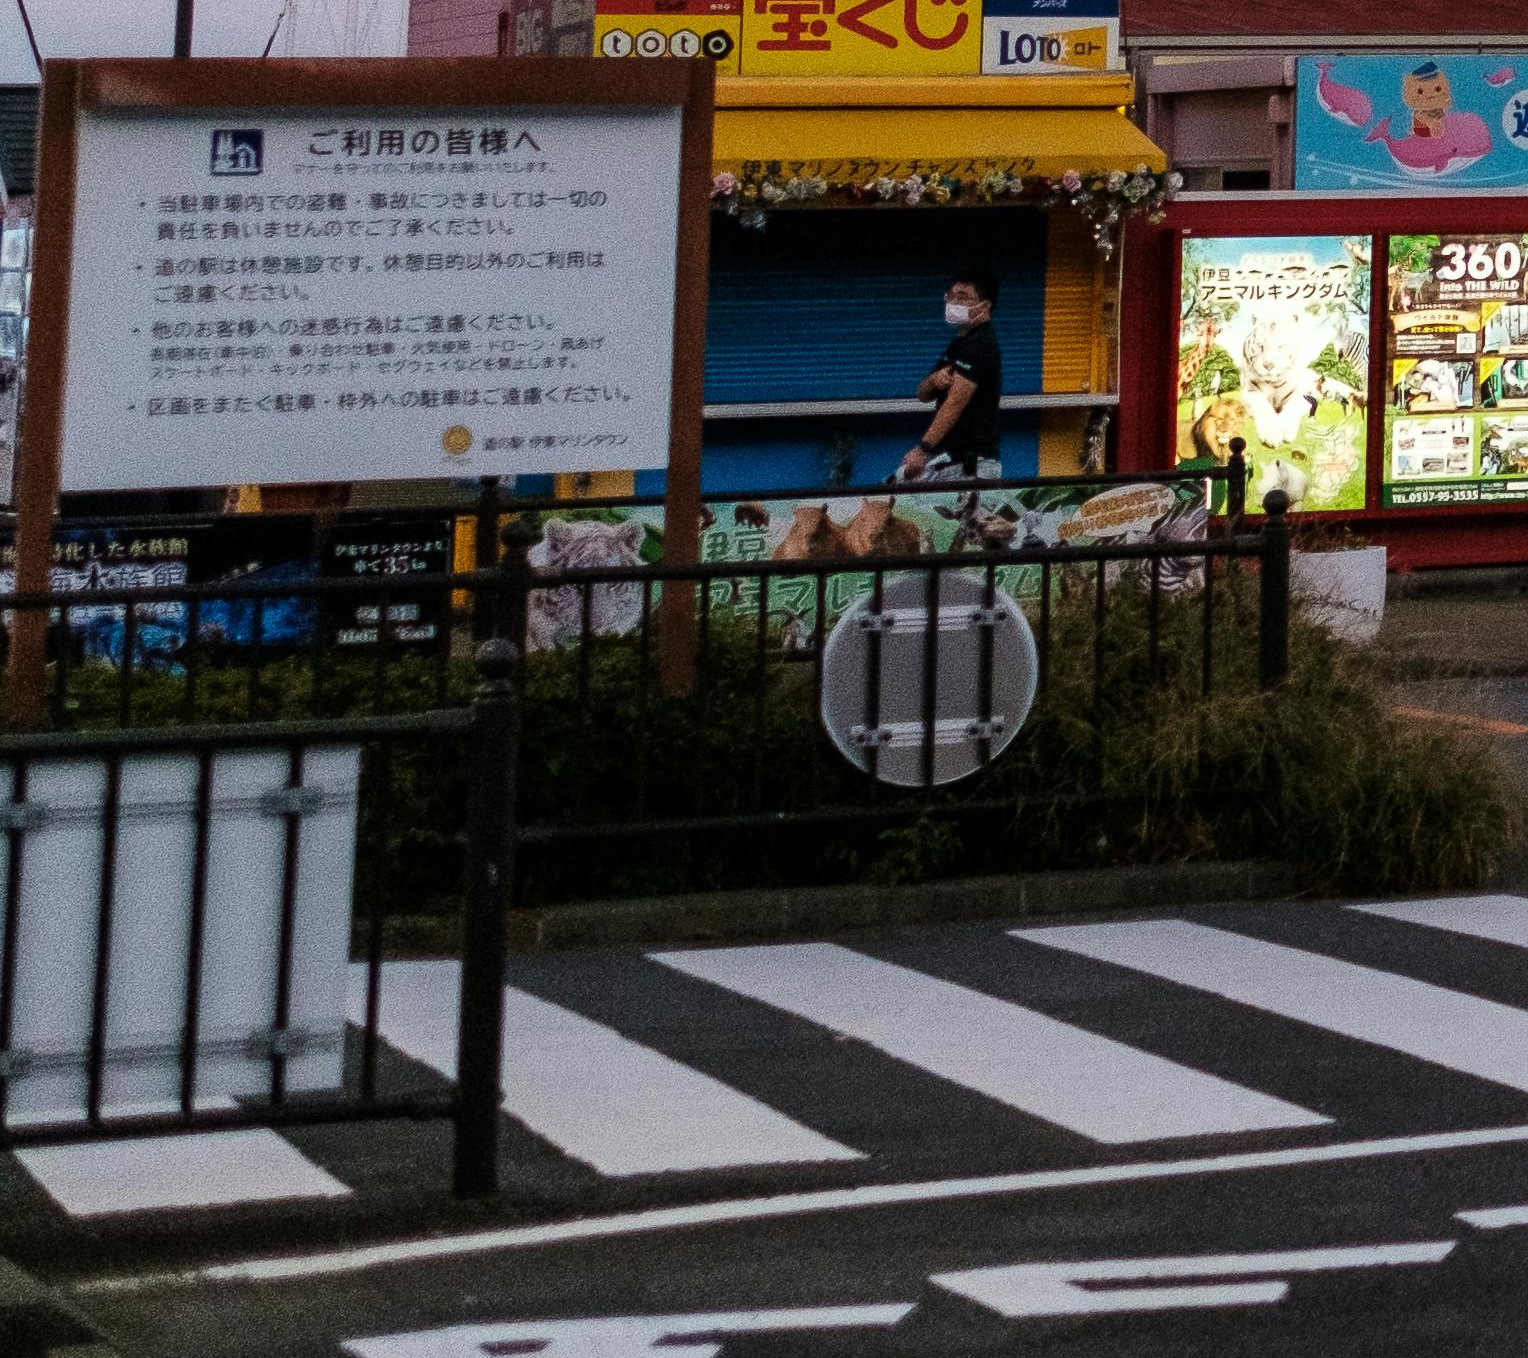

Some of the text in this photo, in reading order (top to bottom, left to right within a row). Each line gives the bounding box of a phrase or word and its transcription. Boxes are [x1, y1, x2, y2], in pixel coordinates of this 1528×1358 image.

[608, 32, 731, 61] toto
[1001, 29, 1061, 65] LOTO
[309, 127, 542, 156] ご利用の皆様へ
[1202, 268, 1231, 281] 伊豆
[1438, 241, 1522, 280] 360
[1201, 284, 1348, 301] アニマルキングダム
